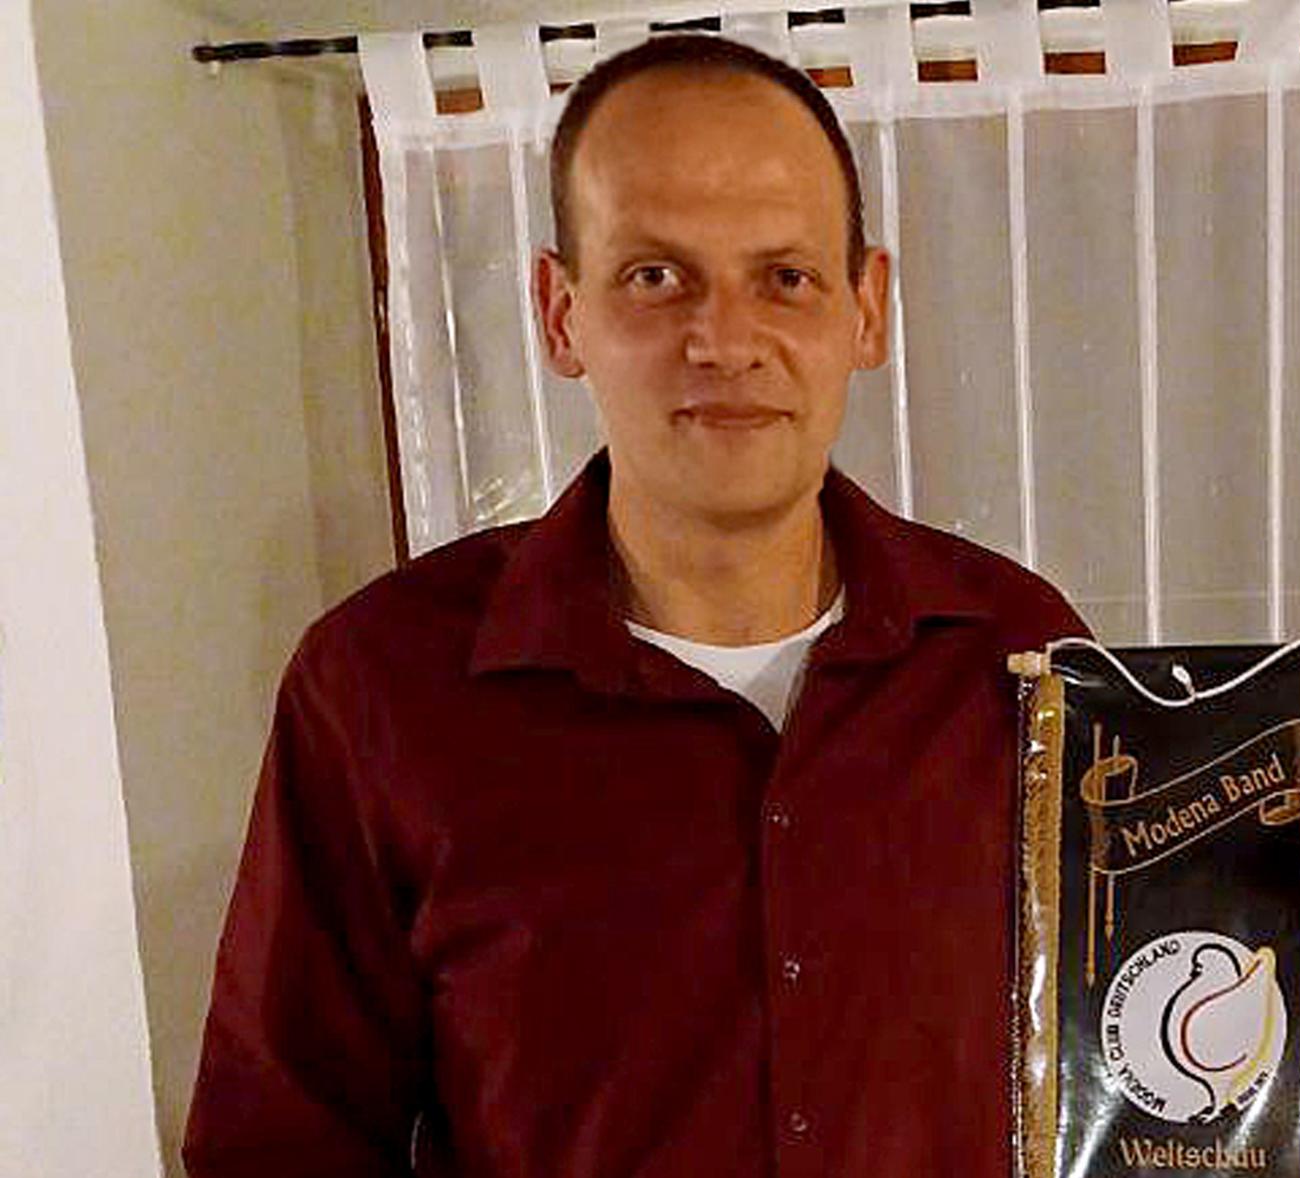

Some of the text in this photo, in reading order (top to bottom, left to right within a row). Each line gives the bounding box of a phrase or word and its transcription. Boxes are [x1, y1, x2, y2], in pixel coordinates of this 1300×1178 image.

[1121, 754, 1286, 857] Modena Band
[1107, 940, 1182, 1018] DEUTSCHLAND
[1119, 1137, 1267, 1169] Weltschau
